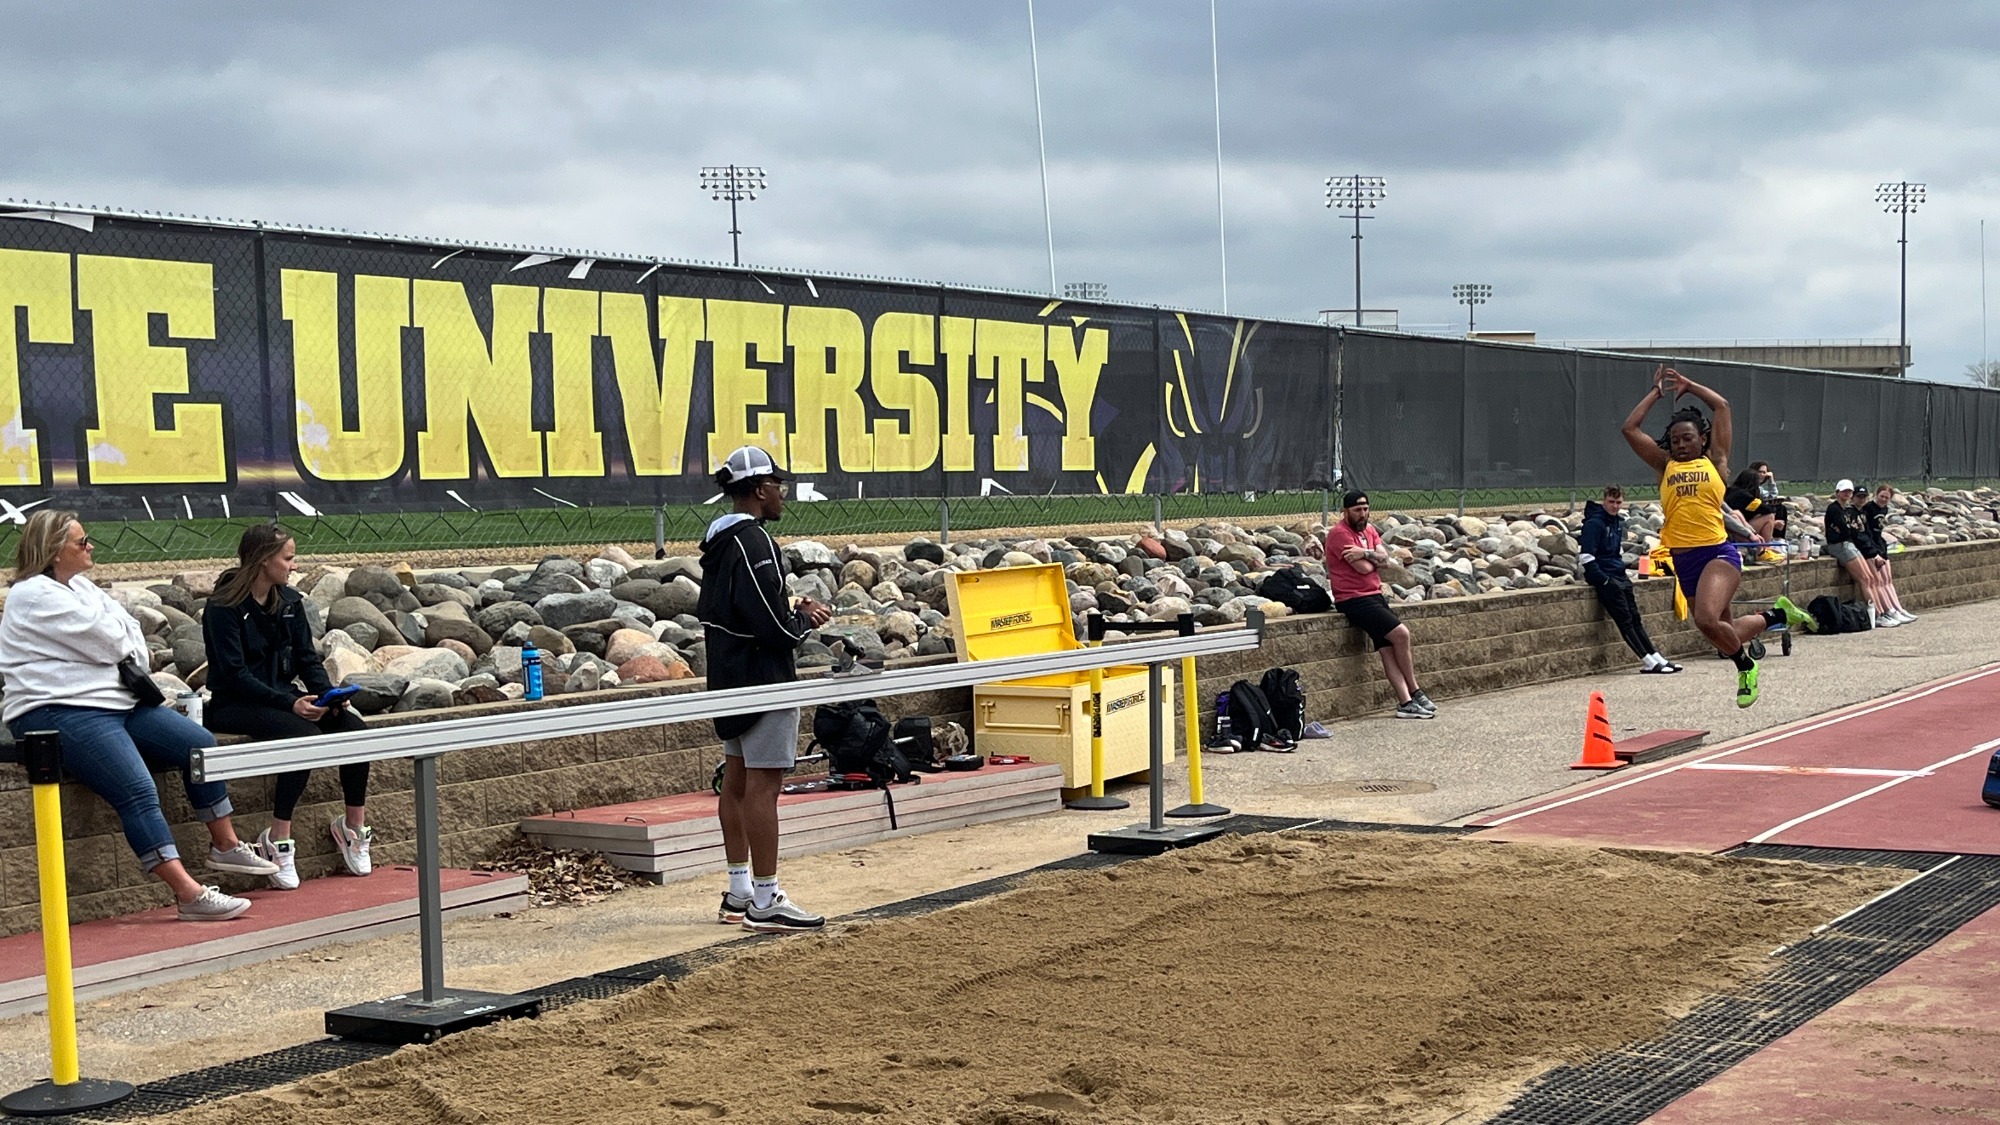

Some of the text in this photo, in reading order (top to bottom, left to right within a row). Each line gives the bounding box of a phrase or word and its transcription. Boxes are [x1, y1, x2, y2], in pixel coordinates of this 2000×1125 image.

[280, 267, 1109, 481] UNIVERSITY
[1667, 471, 1710, 487] MINNESOTA
[1676, 484, 1698, 497] STATE
